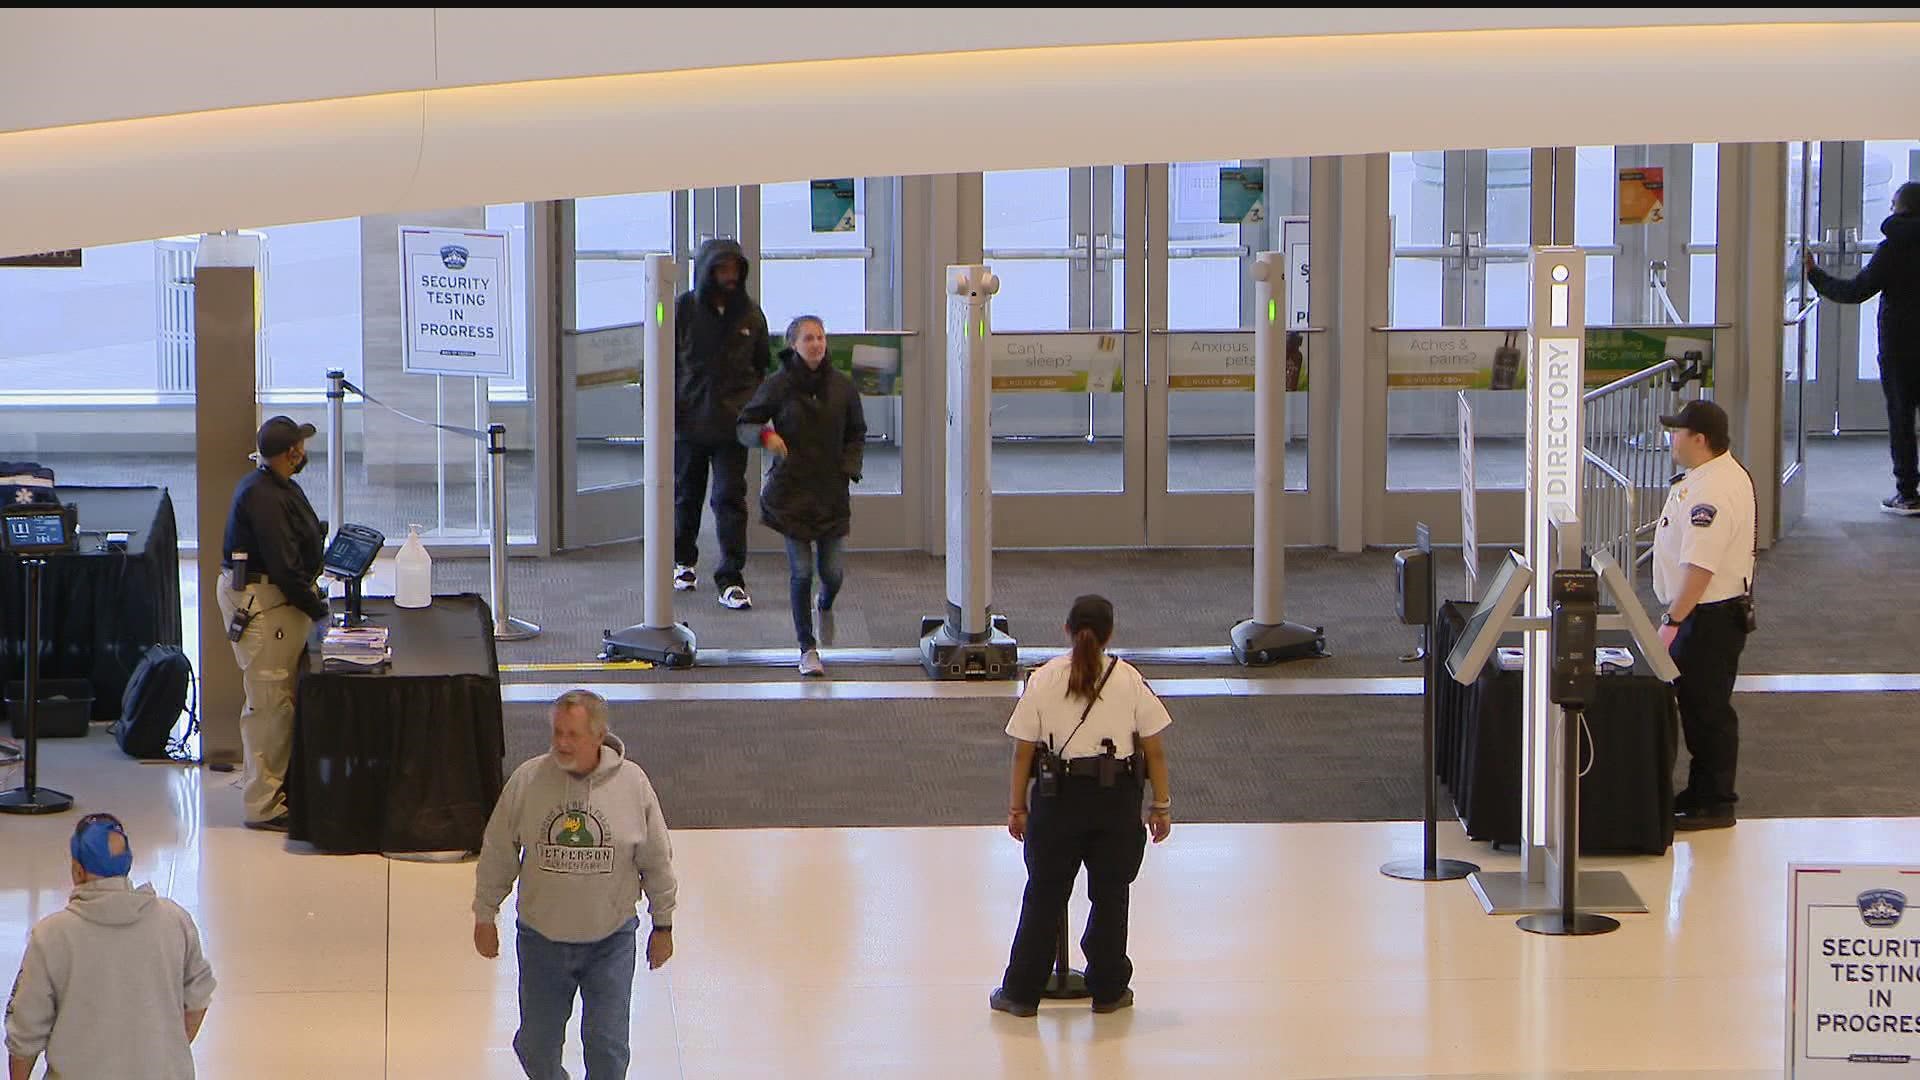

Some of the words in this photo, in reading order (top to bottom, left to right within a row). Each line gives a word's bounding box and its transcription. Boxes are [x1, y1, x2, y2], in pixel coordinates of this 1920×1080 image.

[421, 275, 490, 290] SECURITY
[427, 291, 486, 306] TESTING
[450, 309, 464, 320] IN
[420, 323, 495, 339] PROGRESS
[1007, 342, 1044, 354] Can't
[1190, 341, 1249, 352] Anxious
[1410, 339, 1455, 351] Aches
[1459, 339, 1468, 351] &
[1025, 354, 1073, 368] sleep?
[1429, 352, 1477, 365] pains?
[1547, 343, 1569, 496] DIRECTORY
[1869, 988, 1892, 1008] IN
